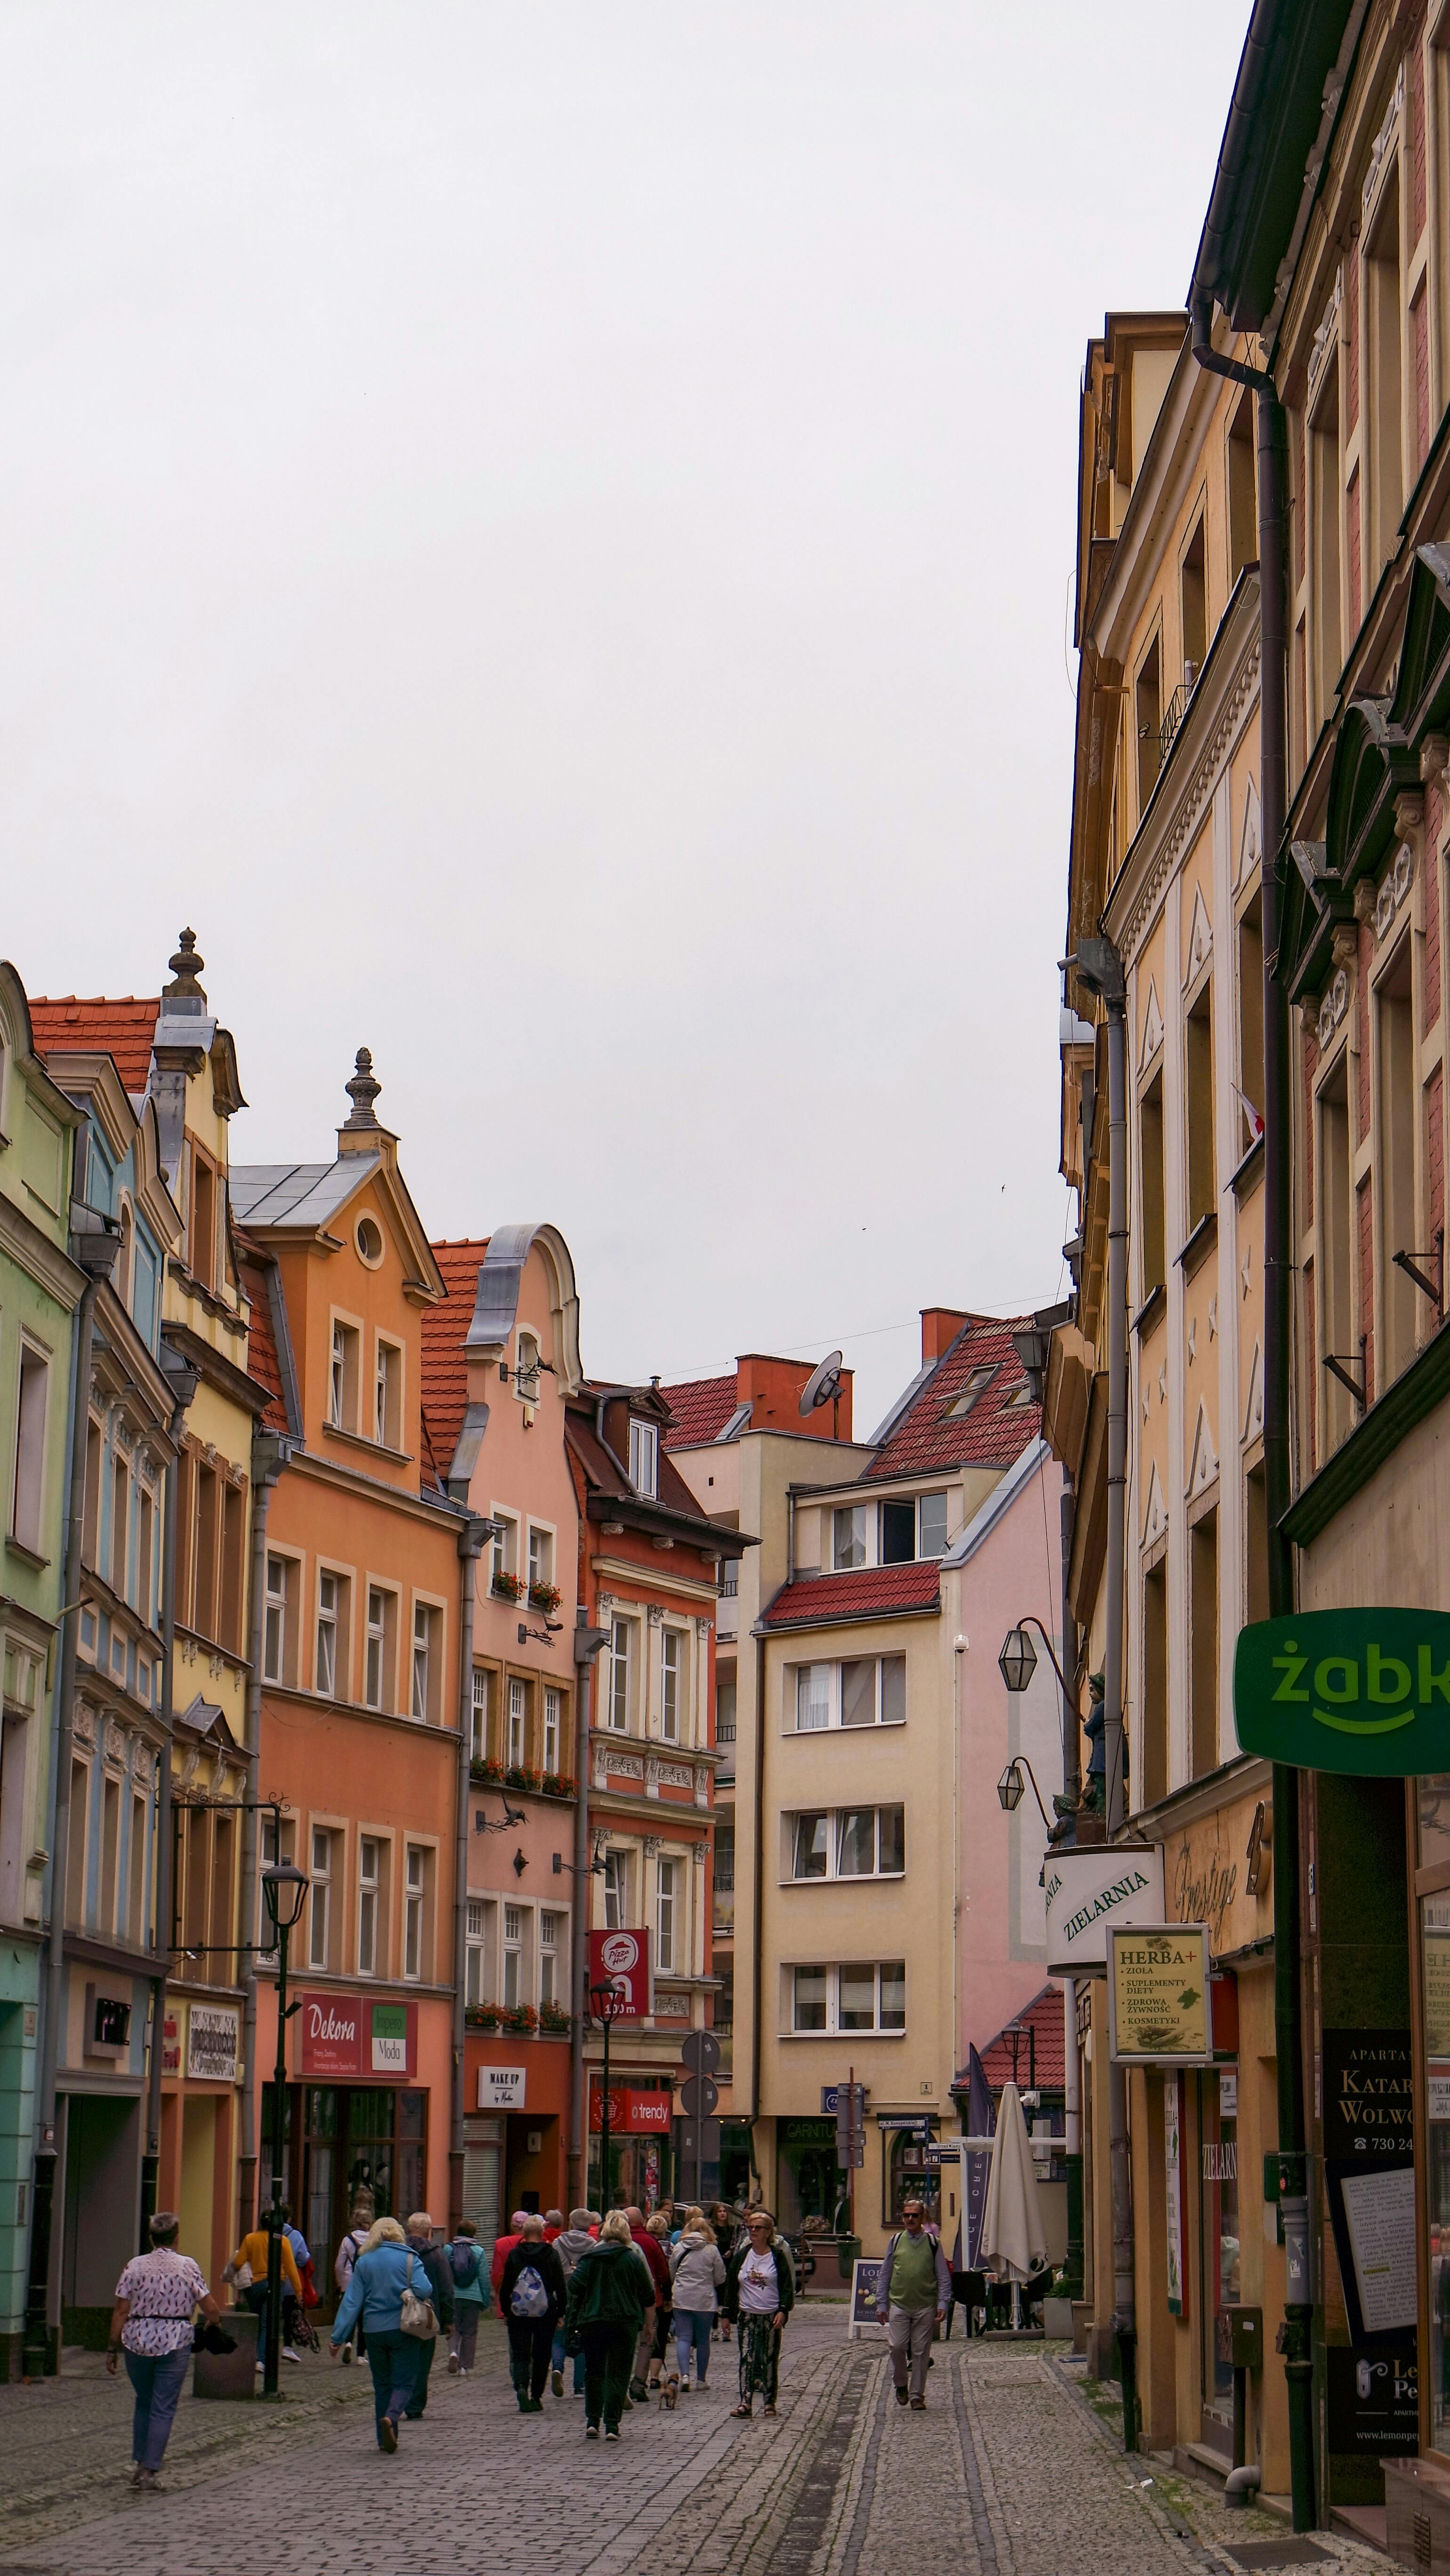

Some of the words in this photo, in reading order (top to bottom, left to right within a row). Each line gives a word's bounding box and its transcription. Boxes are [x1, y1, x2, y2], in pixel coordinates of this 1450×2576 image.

[1063, 1872, 1150, 1942] ZIELARNIA
[609, 1949, 629, 1960] Pizza
[612, 1956, 628, 1966] Hut
[604, 2004, 625, 2014] 100
[1127, 2005, 1171, 2013] ŻYWNOŚĆ
[308, 2004, 355, 2041] Dekora
[377, 2010, 401, 2036] Impero
[379, 2040, 400, 2059] Moda
[1349, 2049, 1411, 2061] APARTA
[490, 2073, 509, 2084] MAKE
[510, 2074, 519, 2085] UP
[639, 2103, 669, 2124] trendy
[787, 2123, 837, 2138] GARNITU
[1371, 2138, 1394, 2150] 730
